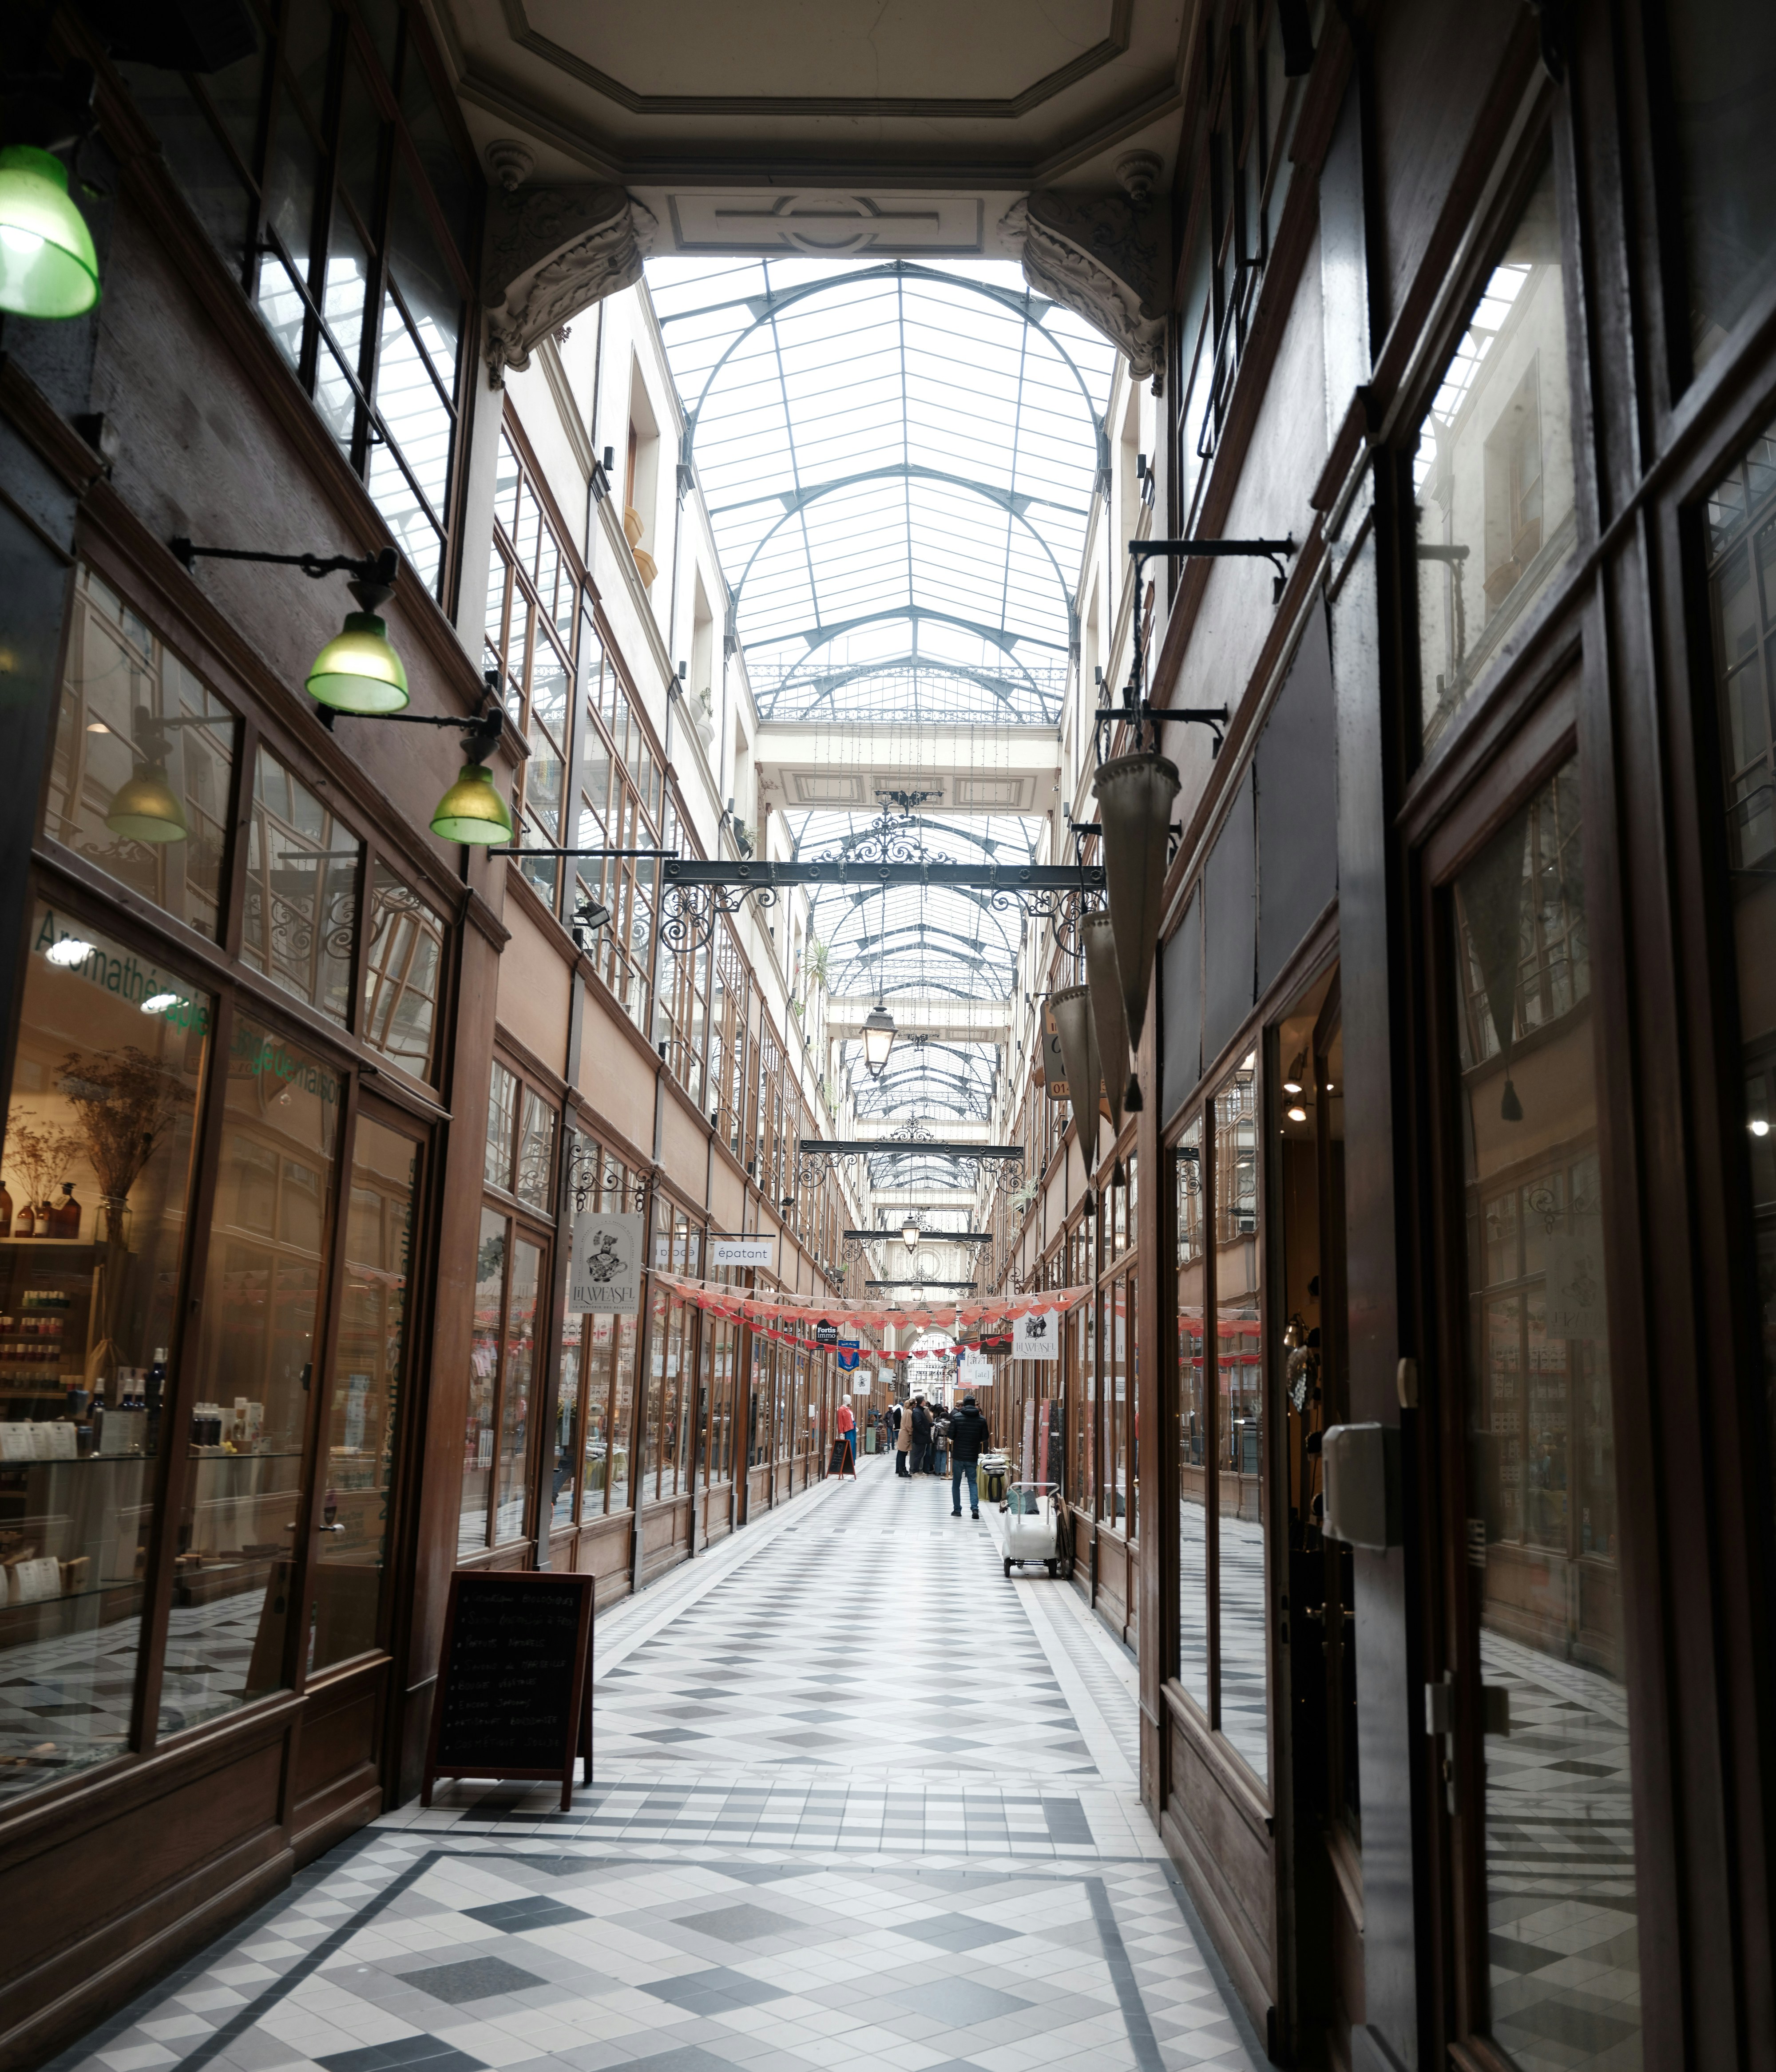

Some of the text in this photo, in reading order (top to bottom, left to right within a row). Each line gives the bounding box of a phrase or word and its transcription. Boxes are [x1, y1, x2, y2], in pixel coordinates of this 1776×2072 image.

[230, 1018, 274, 1075] inge
[718, 1247, 767, 1260] épatant
[587, 1286, 635, 1304] WEASEL
[1025, 1342, 1056, 1354] WEASEL
